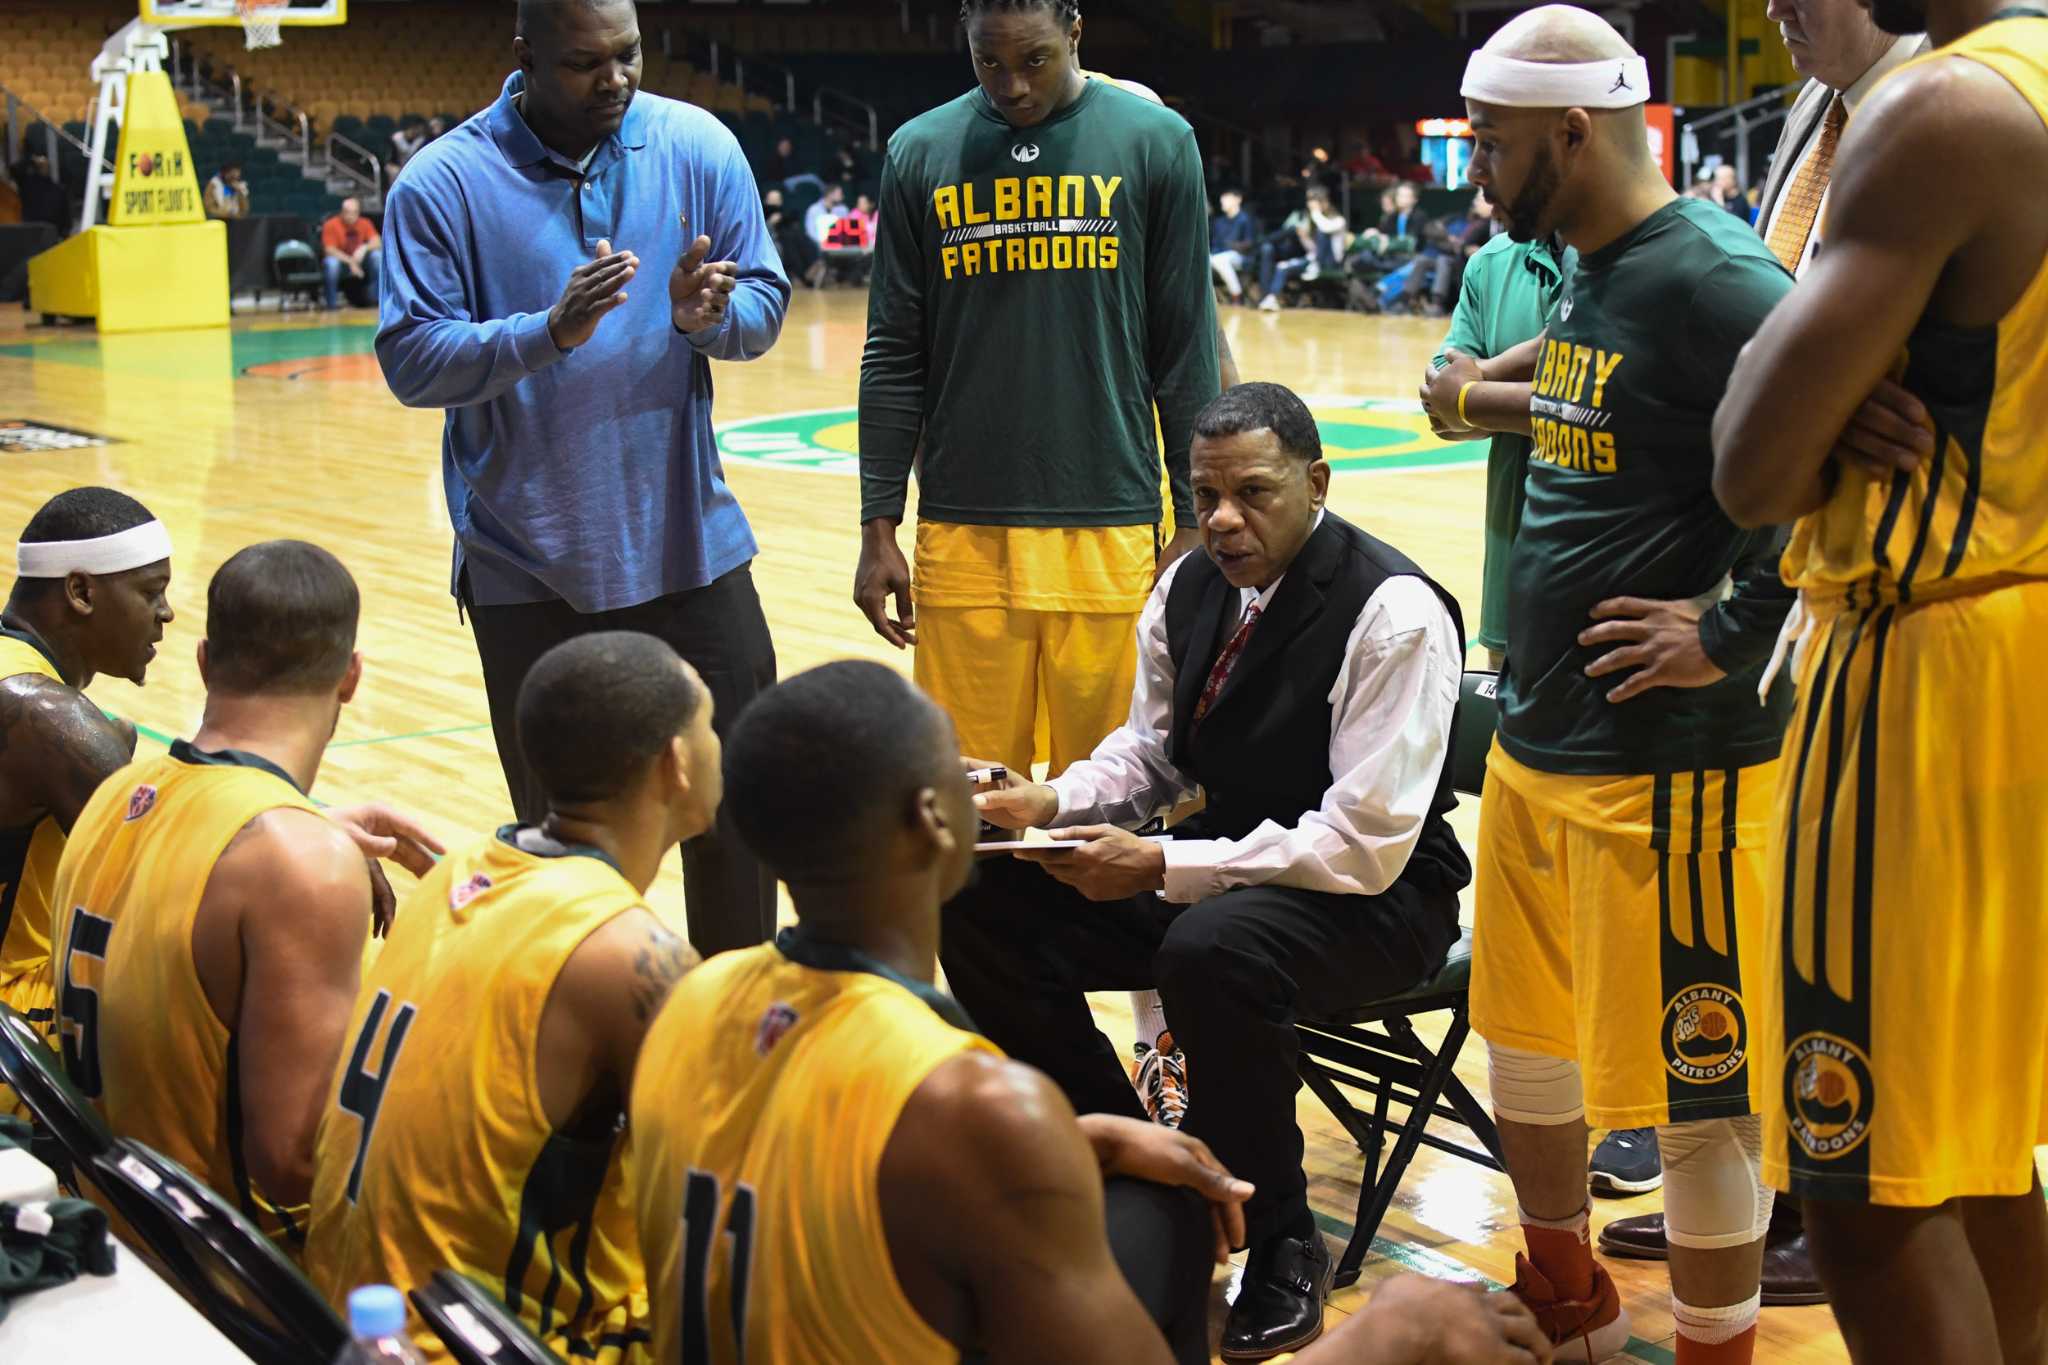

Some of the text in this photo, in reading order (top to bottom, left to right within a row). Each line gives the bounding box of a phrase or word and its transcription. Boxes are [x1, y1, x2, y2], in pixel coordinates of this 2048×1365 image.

[933, 174, 1122, 231] ALBANY
[994, 220, 1059, 235] BASKETBALL
[940, 235, 1120, 281] PATROONS
[1530, 338, 1625, 409] LBANY
[59, 904, 114, 1098] 5
[1674, 988, 1734, 1013] ALBANY
[1671, 1048, 1744, 1078] PATROONS
[337, 986, 418, 1208] 4
